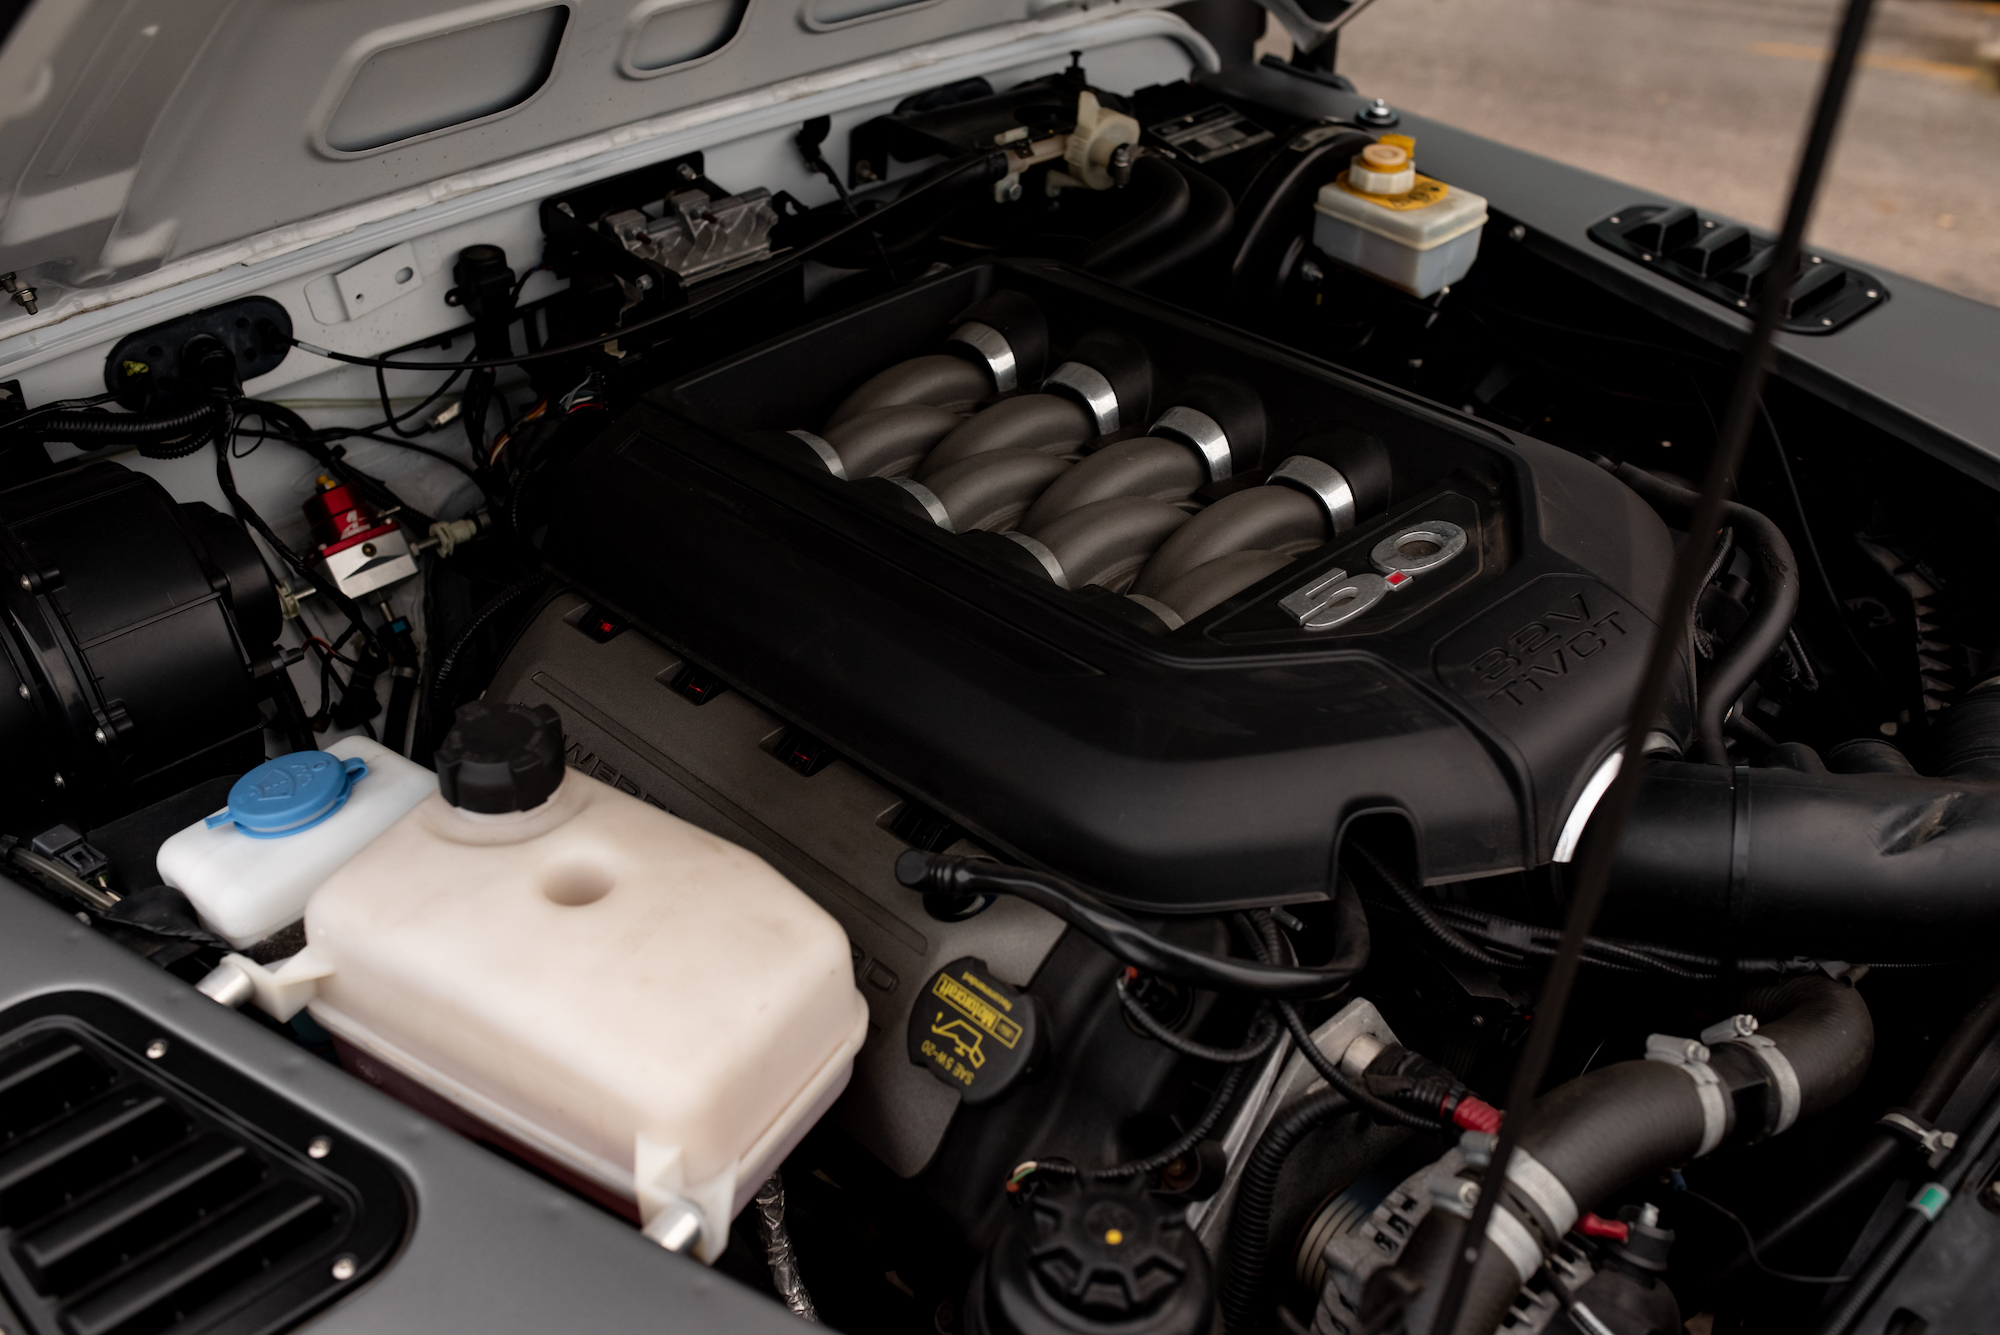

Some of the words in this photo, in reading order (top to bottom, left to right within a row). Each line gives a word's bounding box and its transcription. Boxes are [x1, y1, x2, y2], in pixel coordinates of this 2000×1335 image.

[1277, 519, 1468, 632] 5.0
[1470, 593, 1592, 683] 32V
[938, 979, 997, 1028] Motorcraft
[920, 1039, 955, 1071] 5W-20
[952, 1062, 975, 1086] SAE
